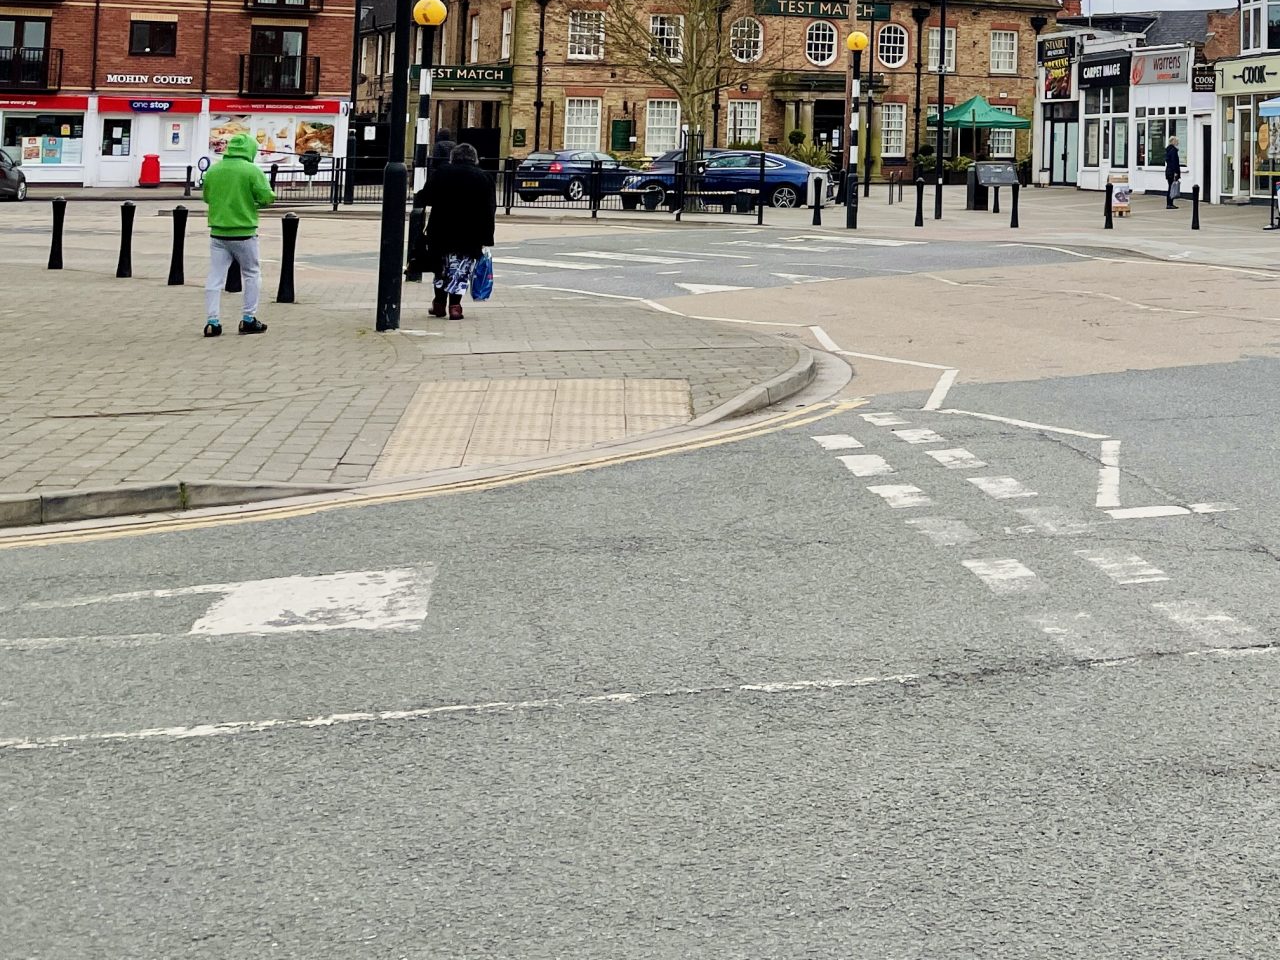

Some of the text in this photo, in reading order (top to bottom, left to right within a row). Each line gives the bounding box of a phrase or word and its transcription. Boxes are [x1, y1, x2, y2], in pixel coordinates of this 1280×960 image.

[778, 0, 815, 14] TEST
[1153, 56, 1180, 70] warrens
[431, 69, 503, 80] EST MATCH
[1083, 63, 1120, 79] CARPET IMAGE
[1242, 65, 1266, 84] COOK
[107, 74, 193, 84] MOHIN COURT
[1194, 76, 1214, 84] COOK
[150, 100, 170, 110] stop
